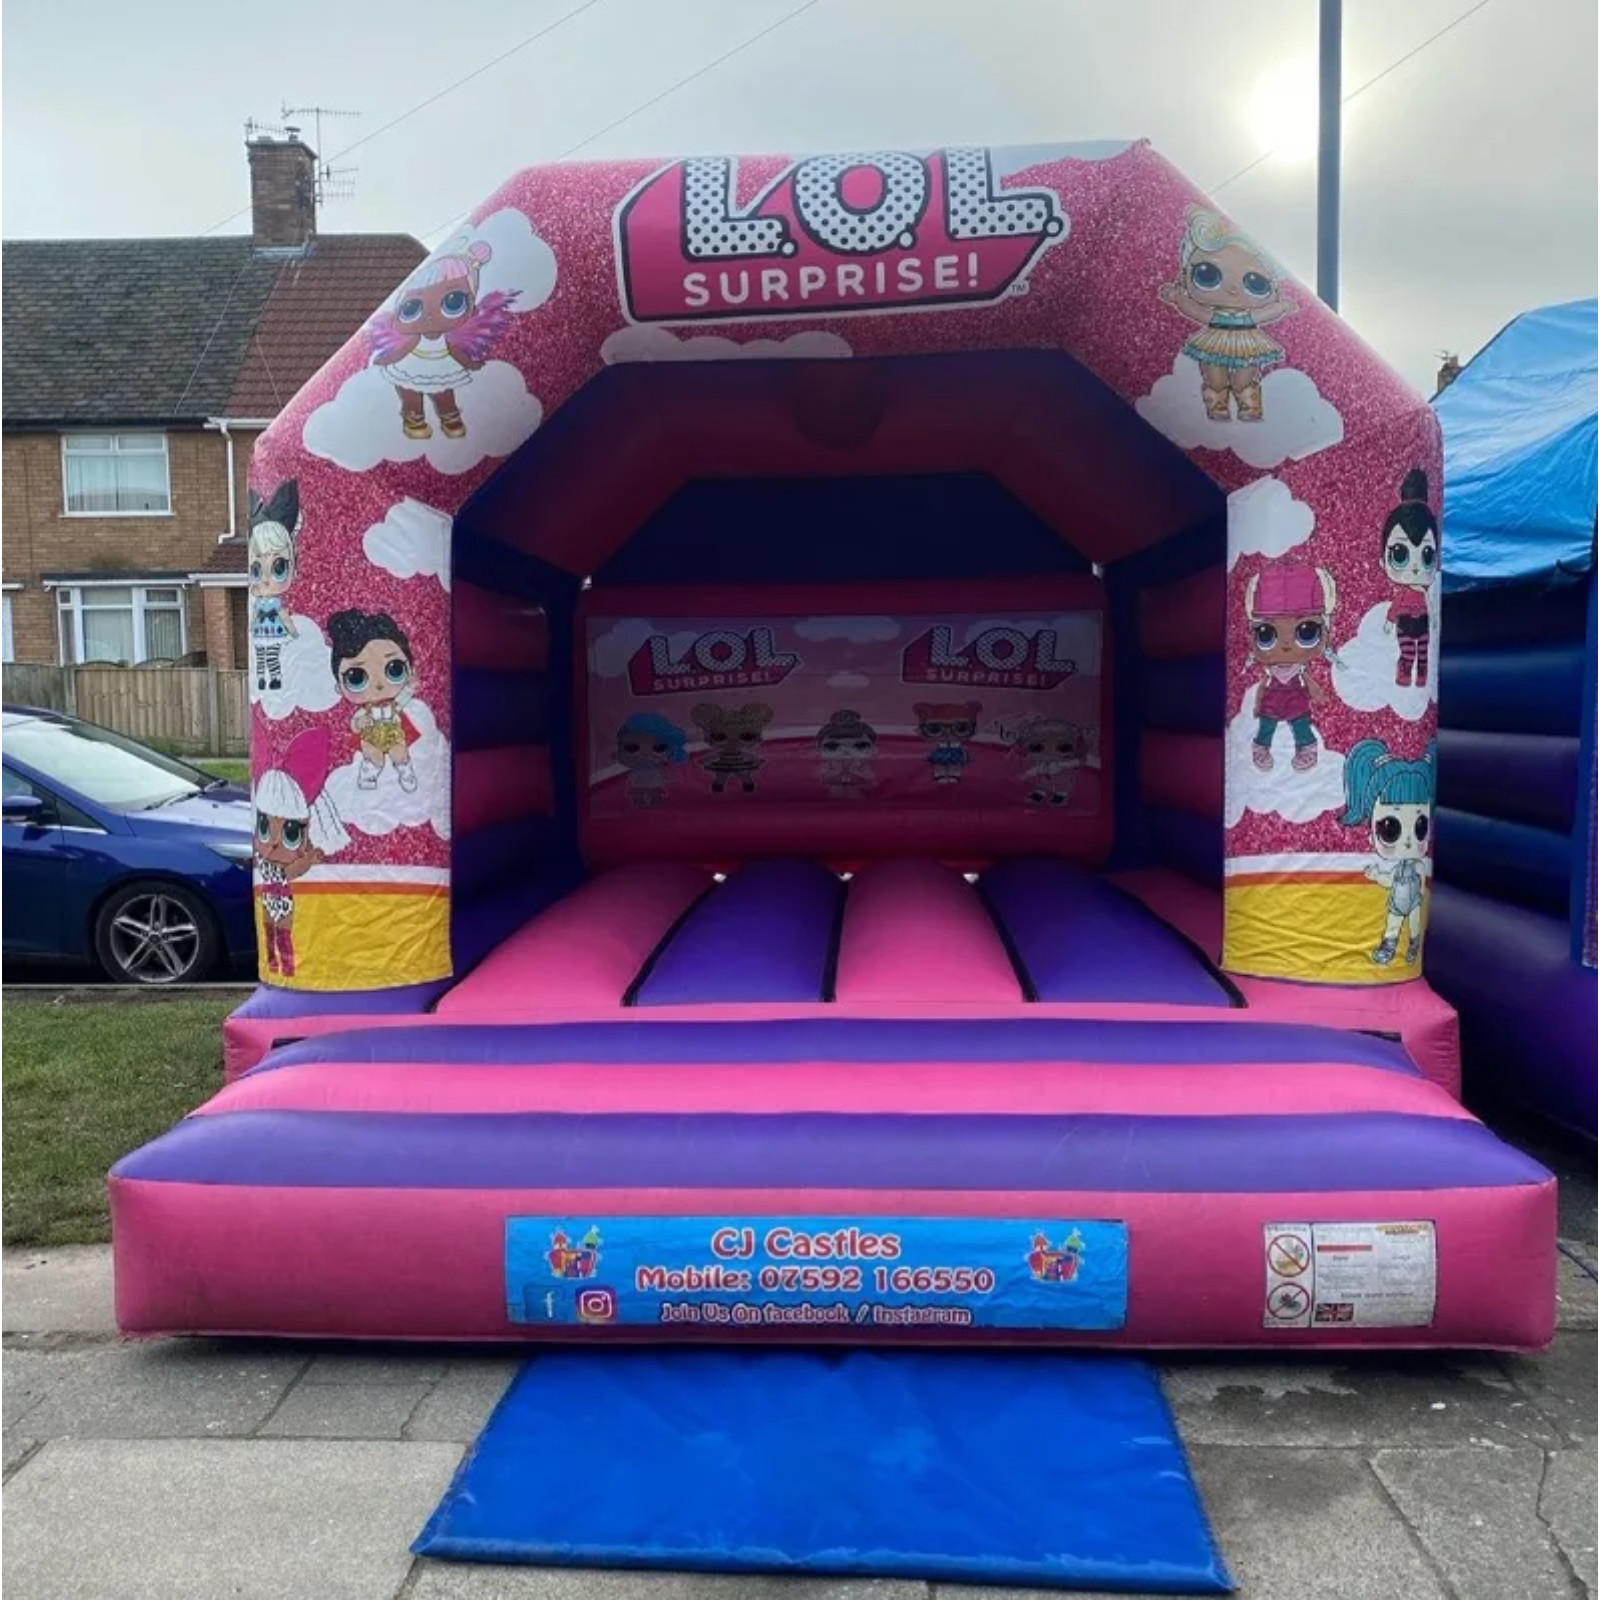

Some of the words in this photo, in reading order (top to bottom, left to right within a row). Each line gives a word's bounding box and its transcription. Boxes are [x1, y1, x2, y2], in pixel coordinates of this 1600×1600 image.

[683, 252, 980, 307] SURPRISE!
[652, 671, 771, 691] SURPRISE!
[925, 668, 1047, 686] SURPRISE!
[711, 1227, 755, 1259] CJ
[766, 1226, 901, 1260] Castles
[636, 1265, 751, 1291] Mobile:
[760, 1266, 862, 1292] 07592
[873, 1266, 995, 1293] 166550
[661, 1303, 700, 1322] Join
[702, 1303, 731, 1322] Us
[731, 1303, 761, 1323] On
[764, 1302, 850, 1324] facebook
